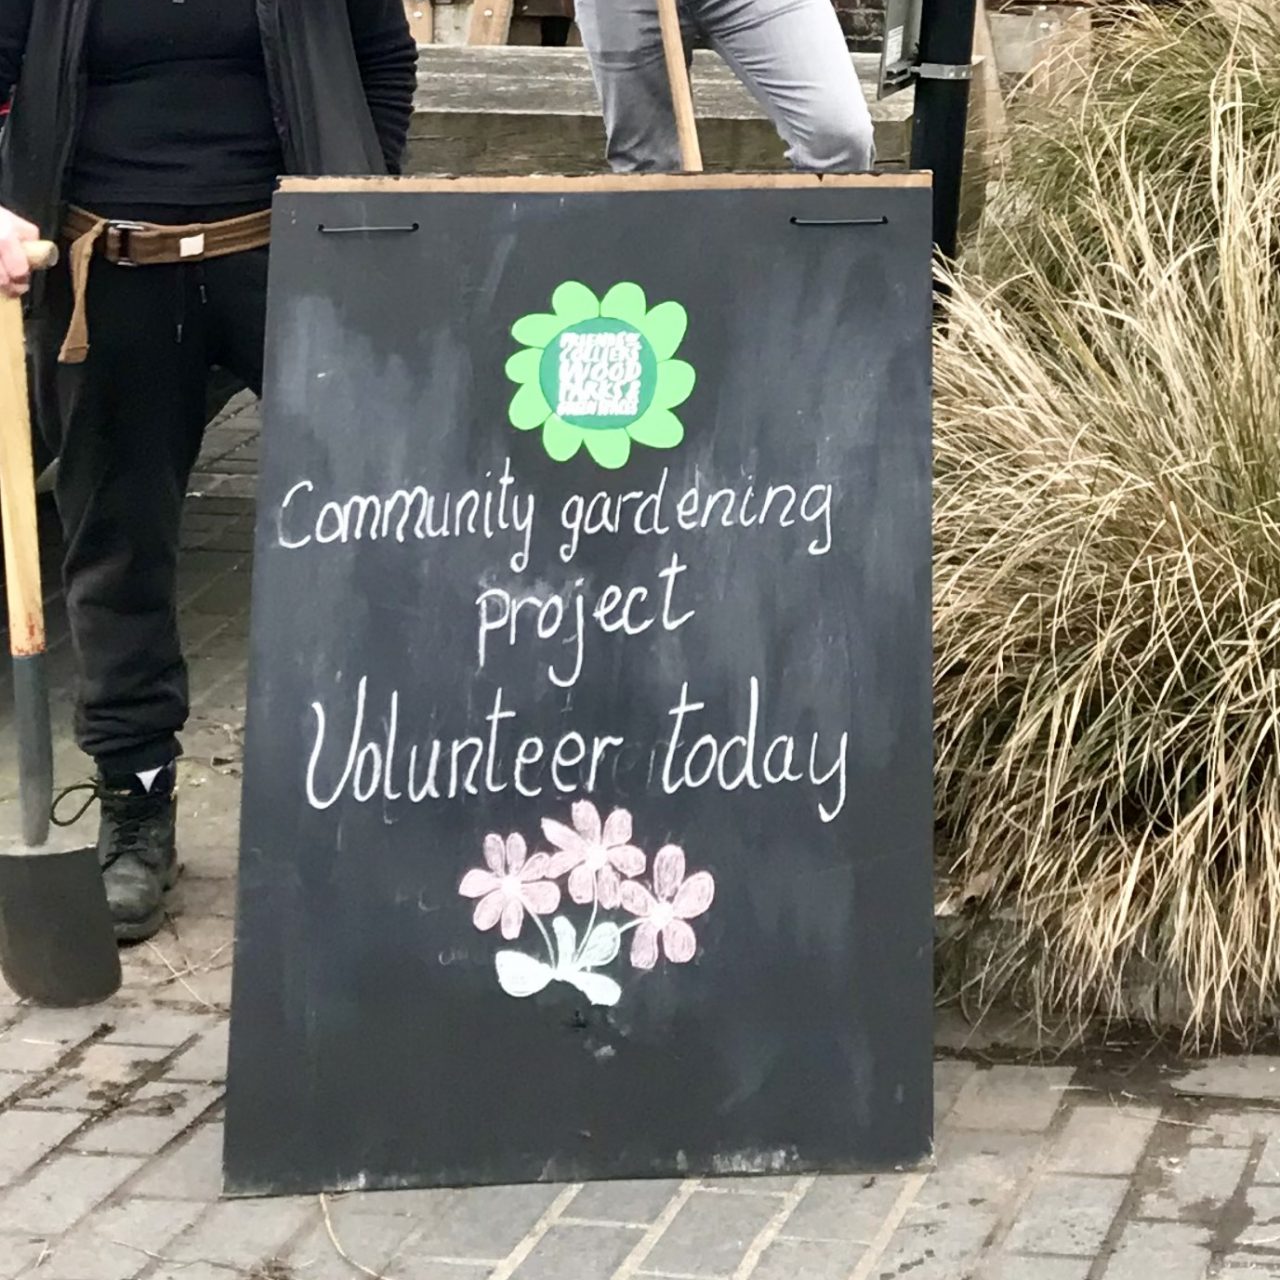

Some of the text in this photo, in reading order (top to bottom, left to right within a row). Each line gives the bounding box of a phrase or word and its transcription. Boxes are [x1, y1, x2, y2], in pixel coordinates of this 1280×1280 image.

[278, 457, 834, 573] Community gardening
[475, 552, 696, 688] project
[305, 675, 849, 823] Volunteer today
